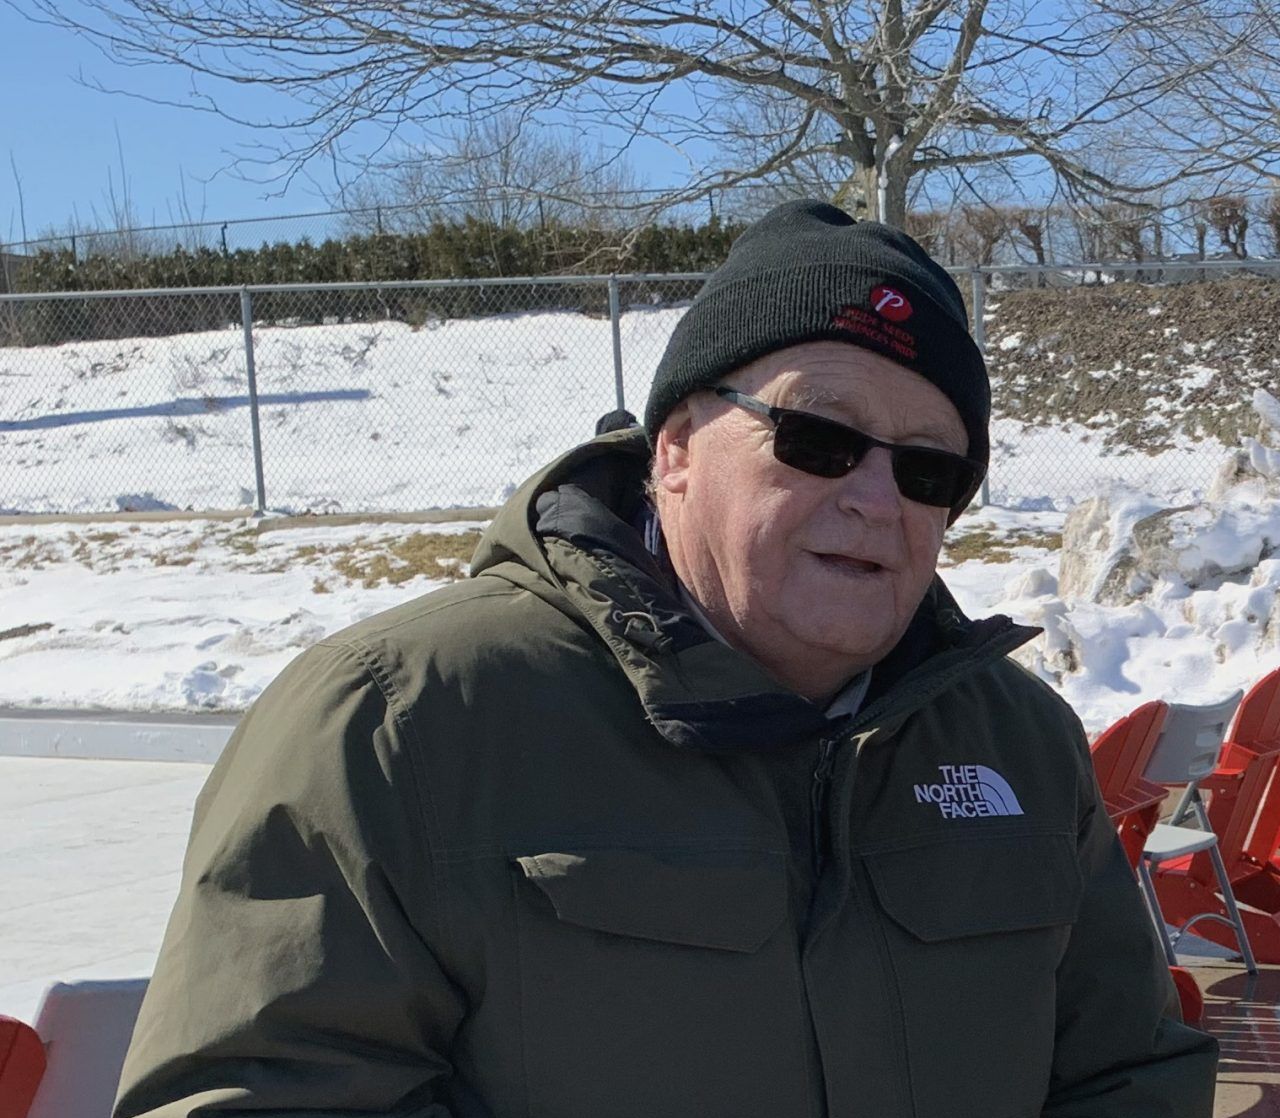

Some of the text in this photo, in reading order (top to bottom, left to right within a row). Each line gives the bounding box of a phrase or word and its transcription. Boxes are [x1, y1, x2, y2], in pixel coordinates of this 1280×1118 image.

[938, 765, 979, 784] THE
[913, 783, 984, 803] NORTH
[939, 801, 989, 819] FACE
